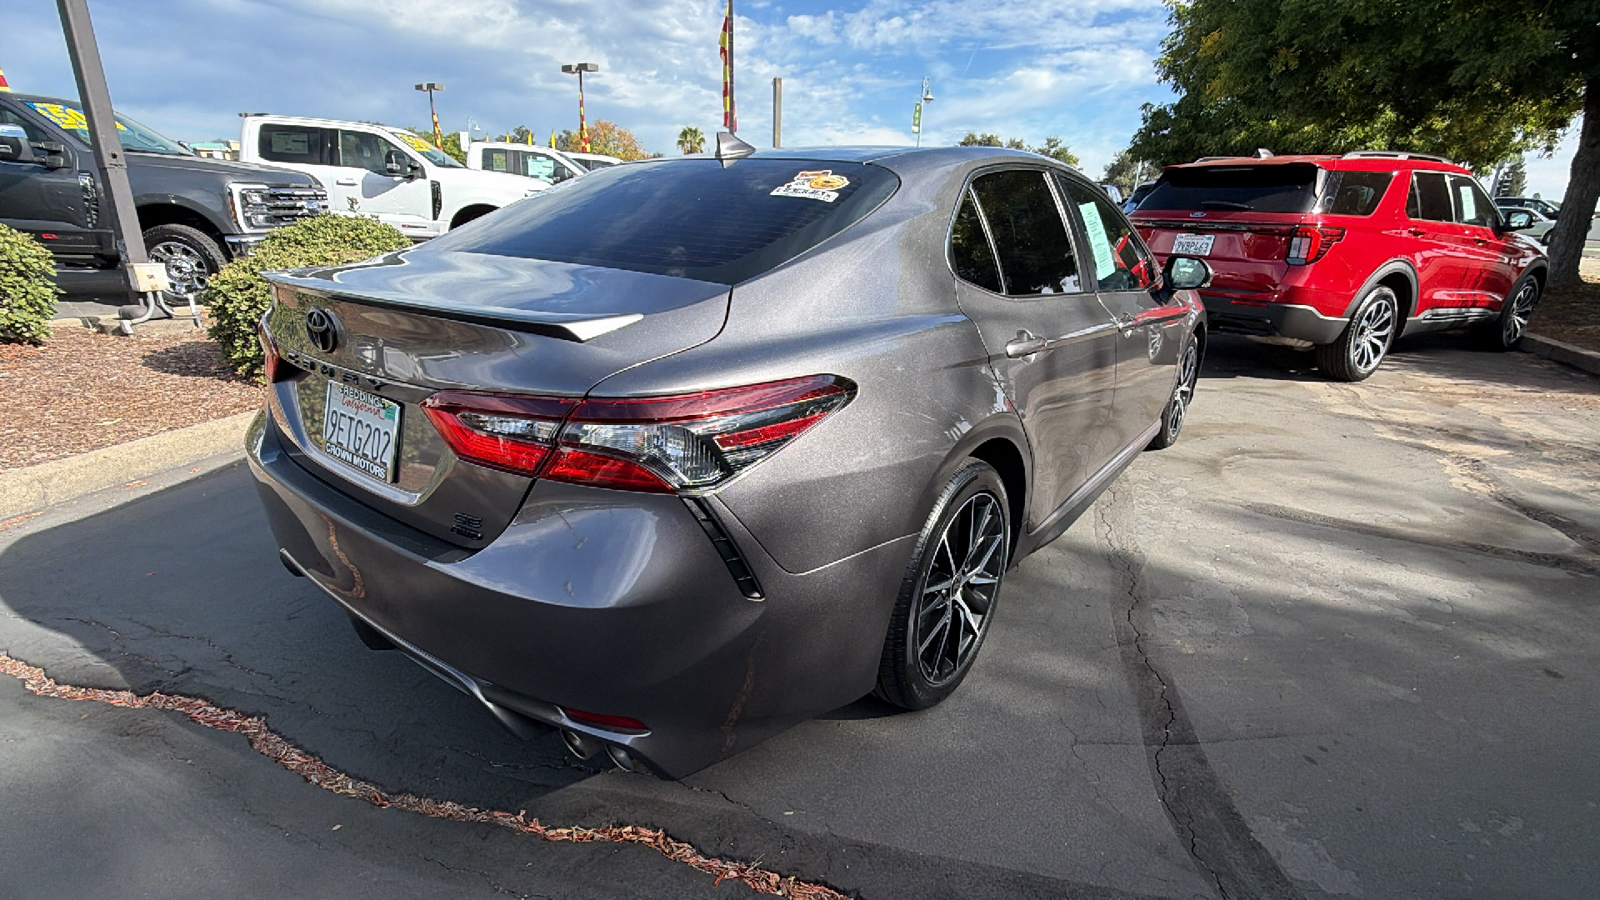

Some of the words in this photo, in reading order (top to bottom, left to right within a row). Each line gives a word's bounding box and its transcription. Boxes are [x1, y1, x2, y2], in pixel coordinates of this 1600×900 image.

[343, 386, 382, 408] REDDING
[328, 410, 391, 468] 9ETG202
[326, 443, 352, 463] CROWN
[353, 456, 386, 480] MOTORS
